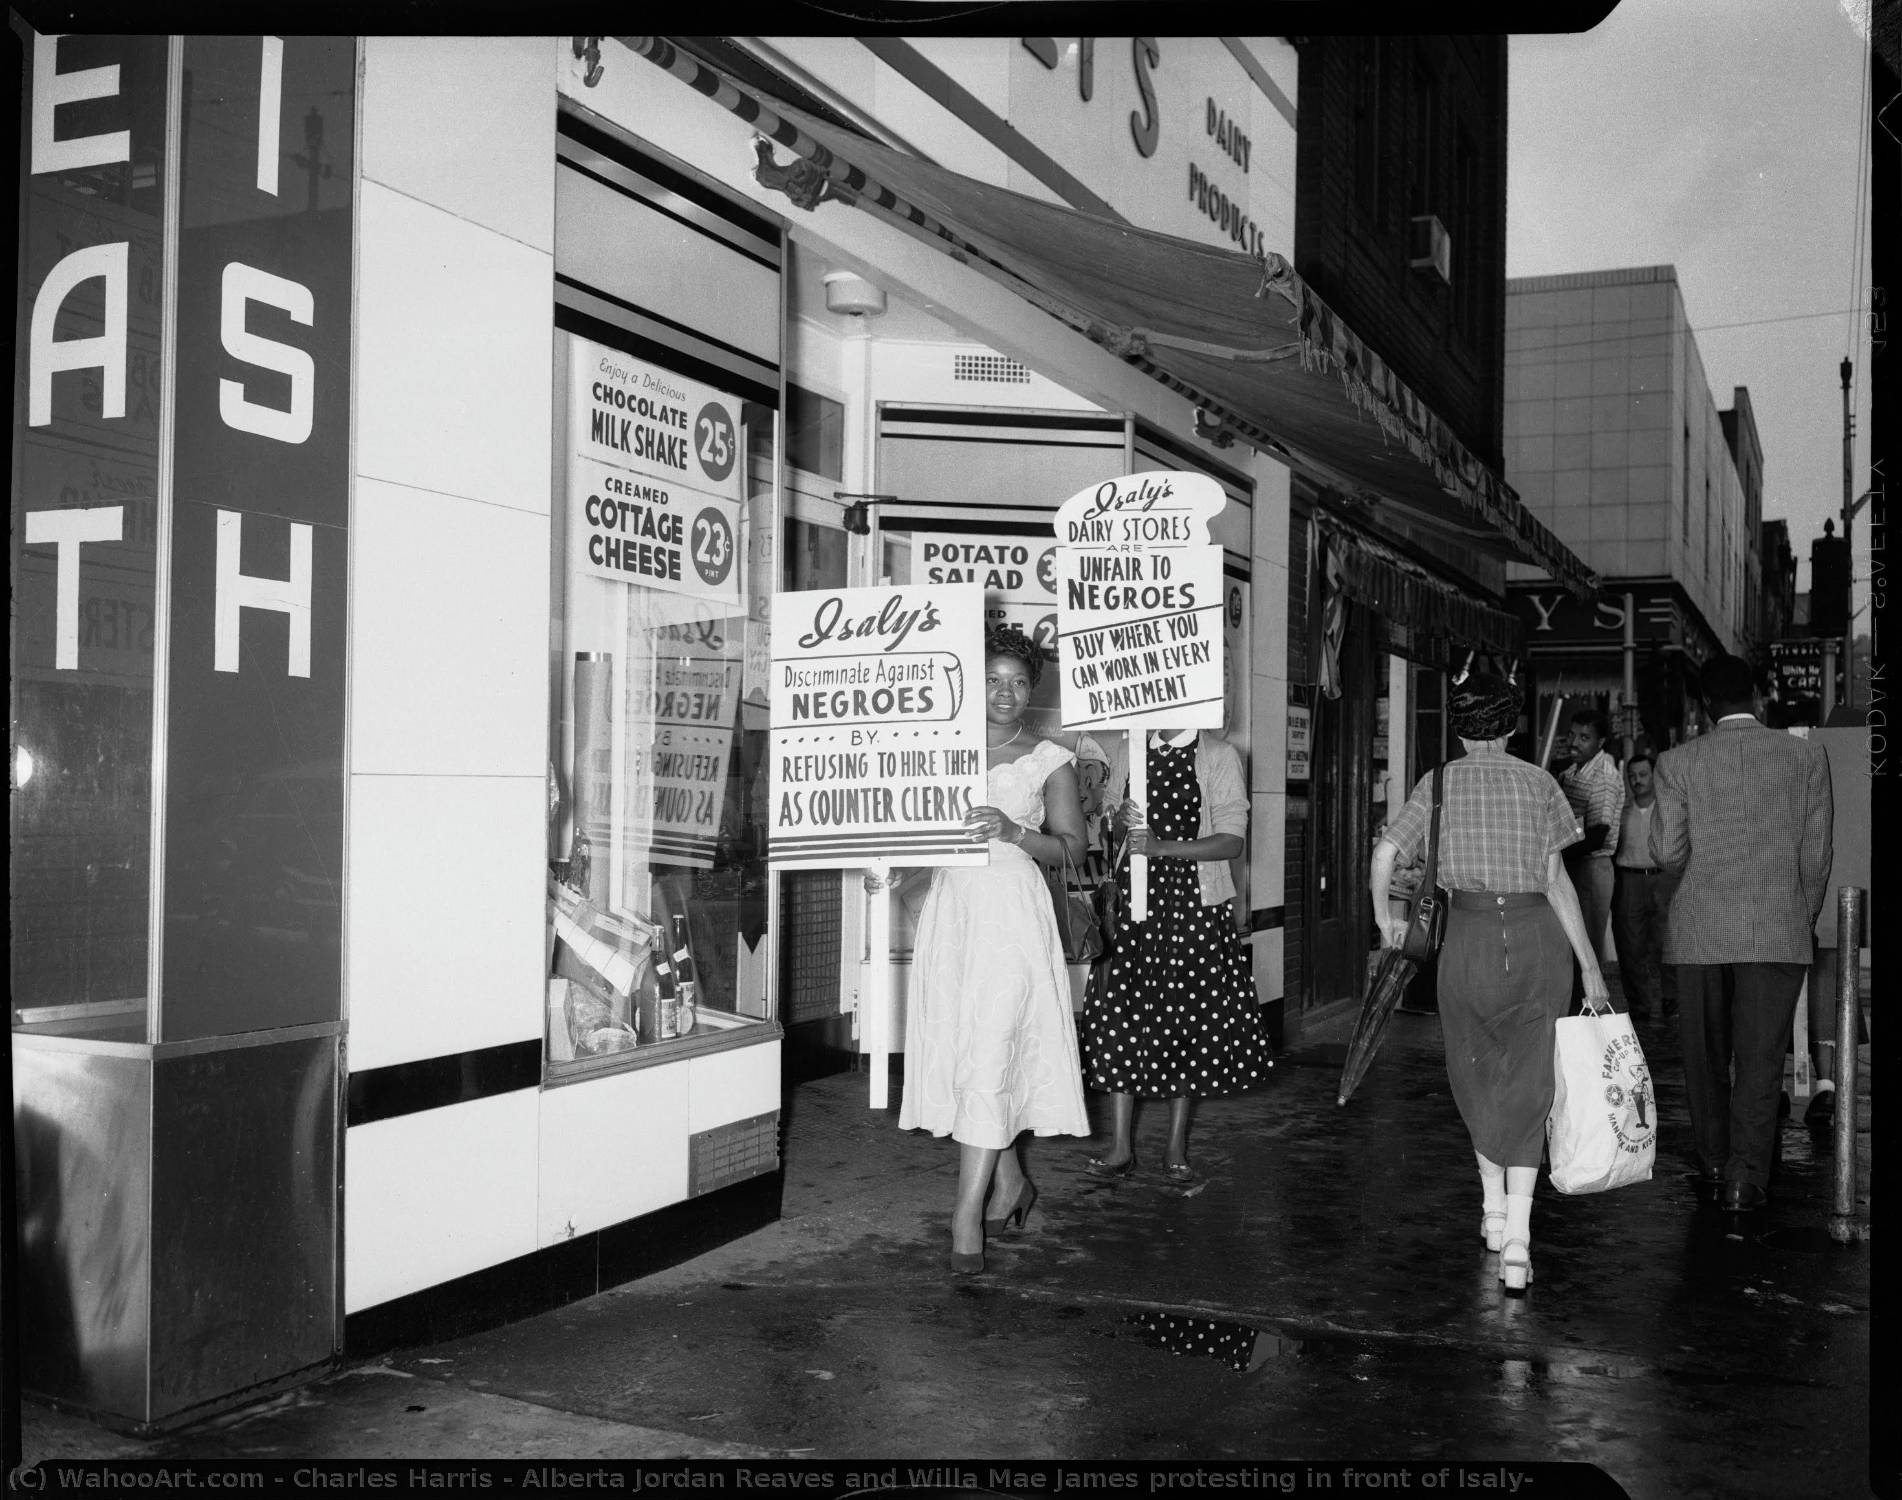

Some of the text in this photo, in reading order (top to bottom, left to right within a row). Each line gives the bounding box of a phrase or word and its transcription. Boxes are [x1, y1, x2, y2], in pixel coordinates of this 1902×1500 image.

[1207, 97, 1251, 174] DAIRY
[1189, 162, 1264, 257] PRODUCTS
[600, 357, 687, 402] Enjoy a Delicious
[592, 381, 688, 430] CHOCOLATE
[604, 477, 670, 505] CREAMED
[1083, 479, 1175, 521] Isaly's
[585, 494, 683, 546] COTTAGE
[1068, 515, 1191, 544] DAIRY STORES
[588, 533, 682, 582] CHEESE
[923, 543, 1029, 566] POTATO
[1079, 554, 1171, 582] UNFAIR TO
[1106, 544, 1144, 553] ARE
[1067, 578, 1196, 611] NEGROES
[798, 593, 943, 652] Isaly's
[1072, 612, 1199, 661] BUY WHERE YOU
[784, 657, 935, 689] Discriminate Against
[1072, 640, 1211, 690] CAN WORK IN EVERY
[791, 685, 934, 721] NEGROES
[1089, 674, 1188, 715] DEPARTMENT
[782, 749, 979, 783] REFUSING TO HIRE THEM
[778, 785, 973, 827] AS COUNTER CLERKS
